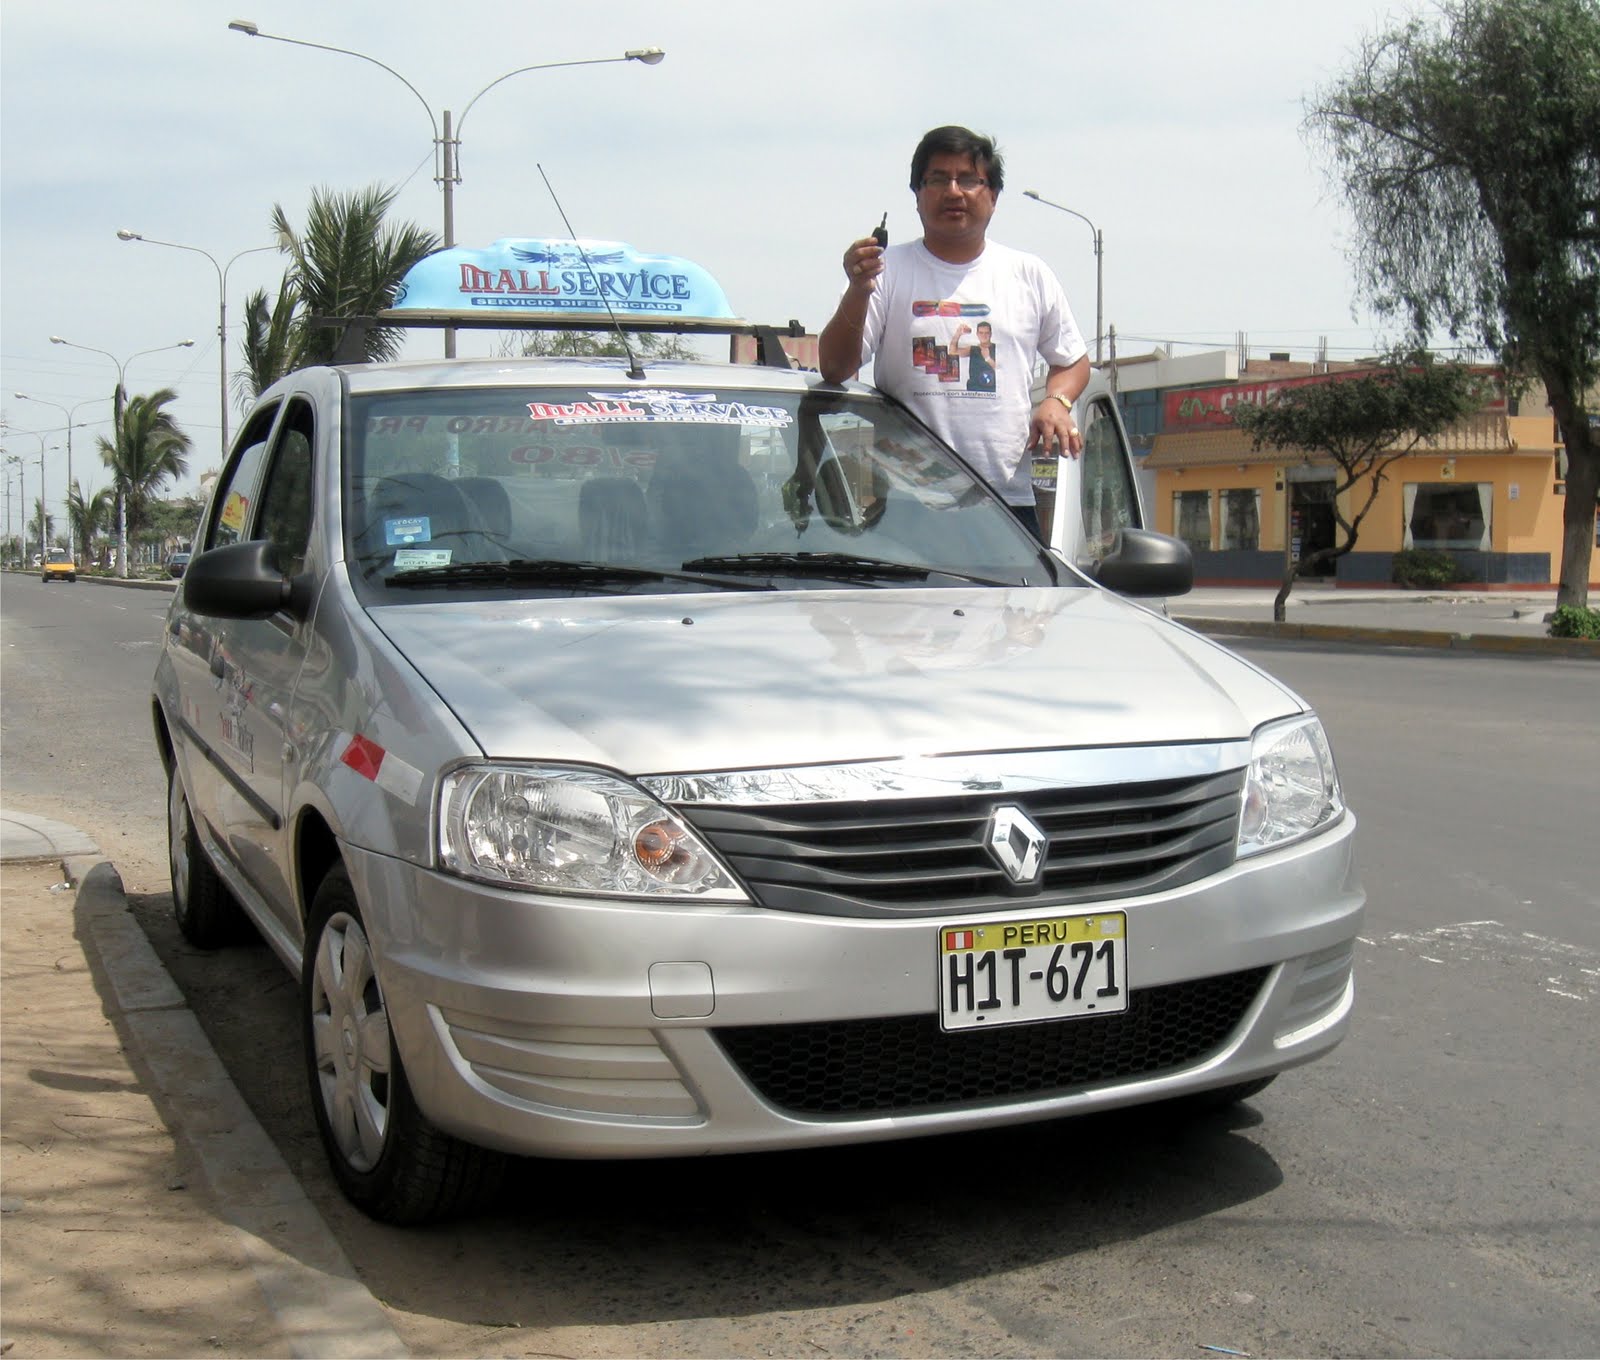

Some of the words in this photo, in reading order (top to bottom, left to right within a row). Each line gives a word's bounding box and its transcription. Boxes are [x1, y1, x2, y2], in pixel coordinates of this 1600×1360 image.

[561, 269, 691, 300] SERVICE
[476, 298, 555, 307] SERVICIO
[560, 300, 679, 311] DIFERENCIADO
[648, 400, 793, 423] SERVICE
[1003, 922, 1068, 947] PERU
[949, 939, 1119, 1013] H1T-671
